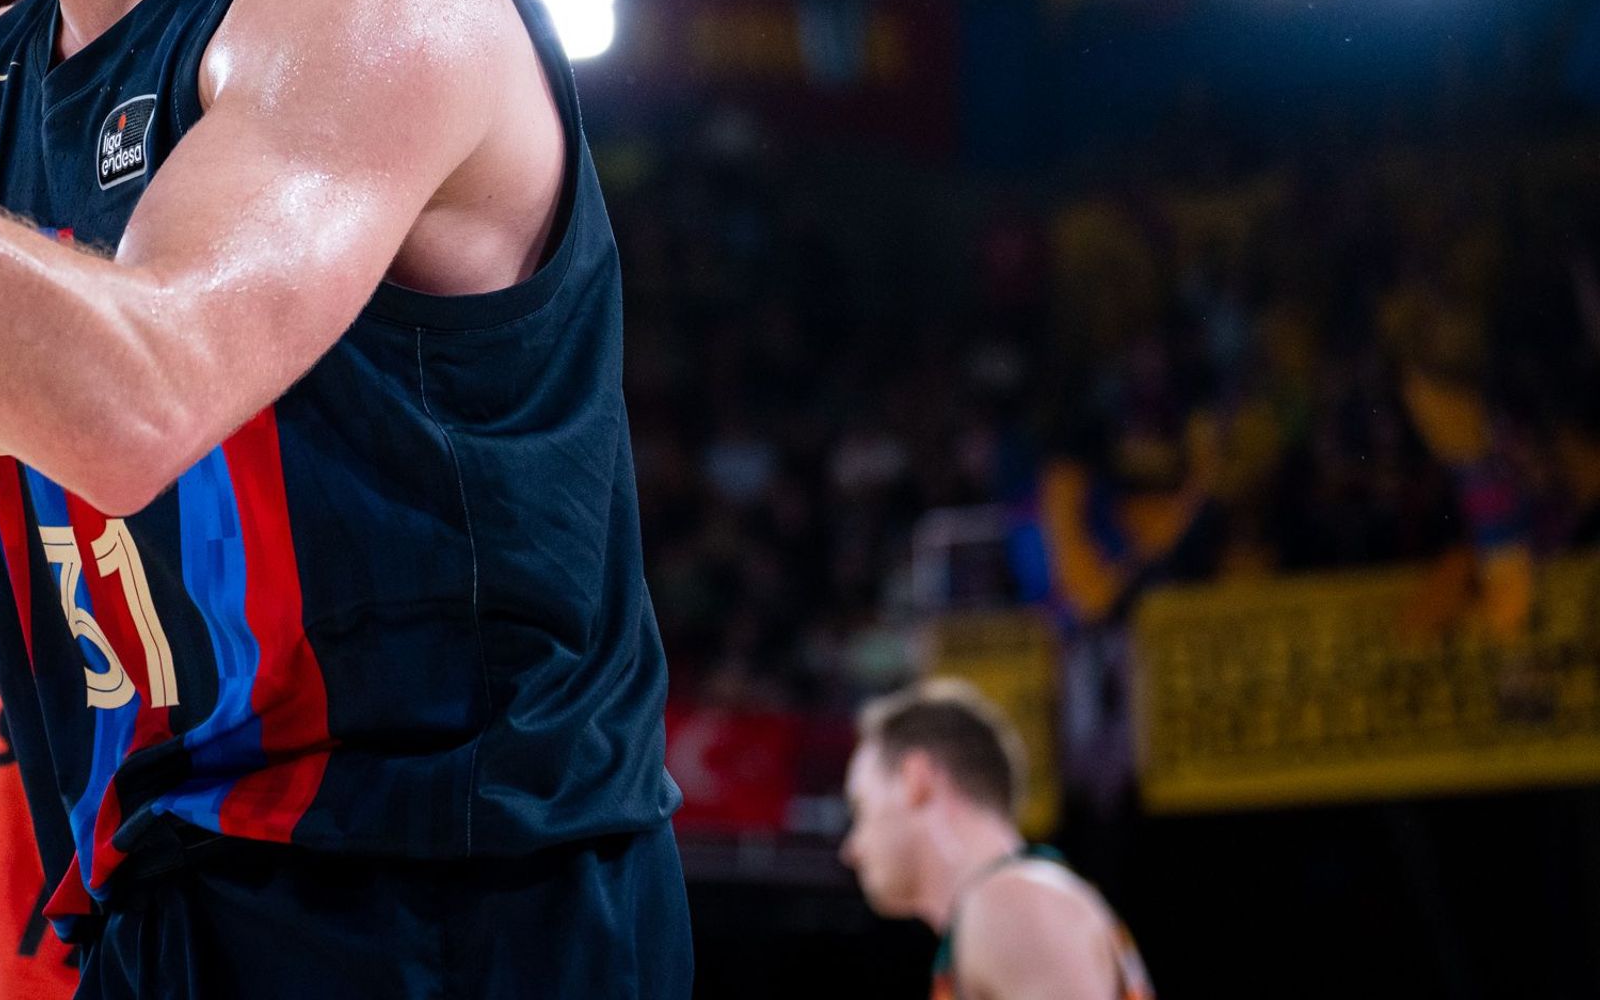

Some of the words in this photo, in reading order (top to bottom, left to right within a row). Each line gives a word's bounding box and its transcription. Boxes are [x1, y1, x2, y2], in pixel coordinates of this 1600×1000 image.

[102, 131, 122, 155] liga
[101, 144, 142, 176] endesa
[38, 518, 179, 709] 31
